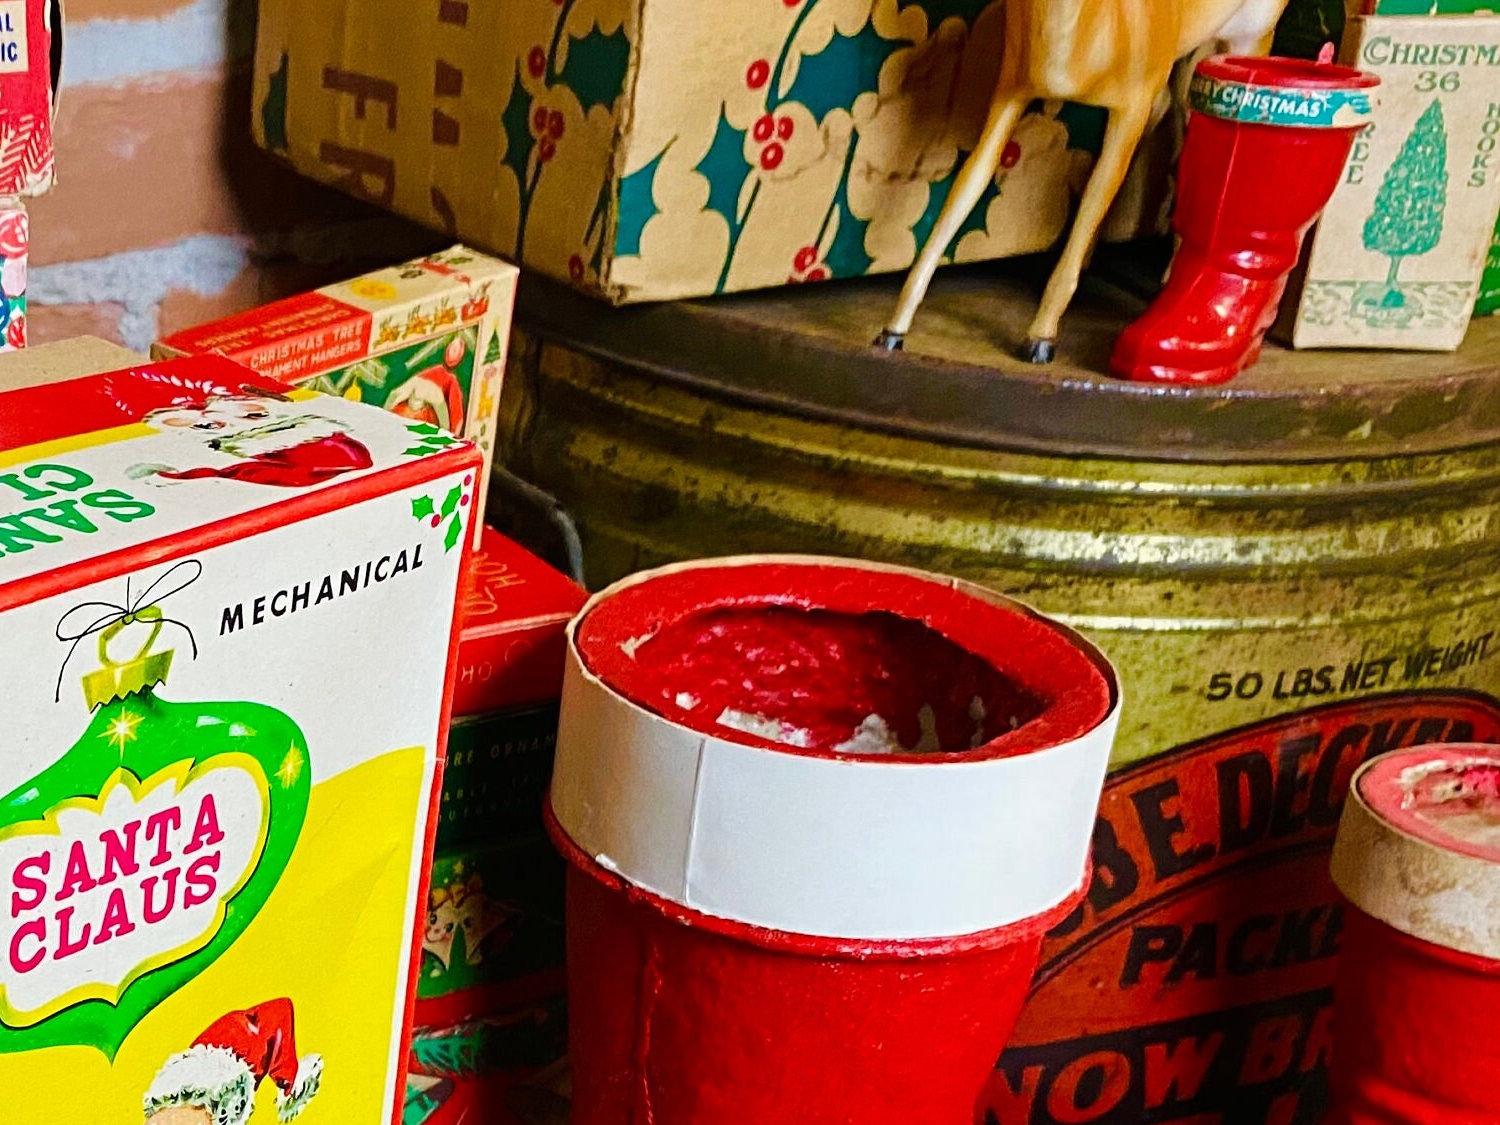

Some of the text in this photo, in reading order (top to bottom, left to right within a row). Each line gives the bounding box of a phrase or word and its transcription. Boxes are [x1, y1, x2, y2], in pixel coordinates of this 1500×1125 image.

[1221, 85, 1321, 118] CHRISTMAS
[1414, 70, 1461, 93] 36
[251, 320, 365, 369] CHRISTMAS TREE
[310, 339, 362, 365] HANGERS
[219, 543, 425, 637] MECHANICAL
[1206, 672, 1264, 702] 50
[1339, 657, 1397, 693] NET
[1402, 631, 1494, 681] WEIGHT
[8, 793, 226, 920] SANTA
[8, 851, 223, 976] CLAUS
